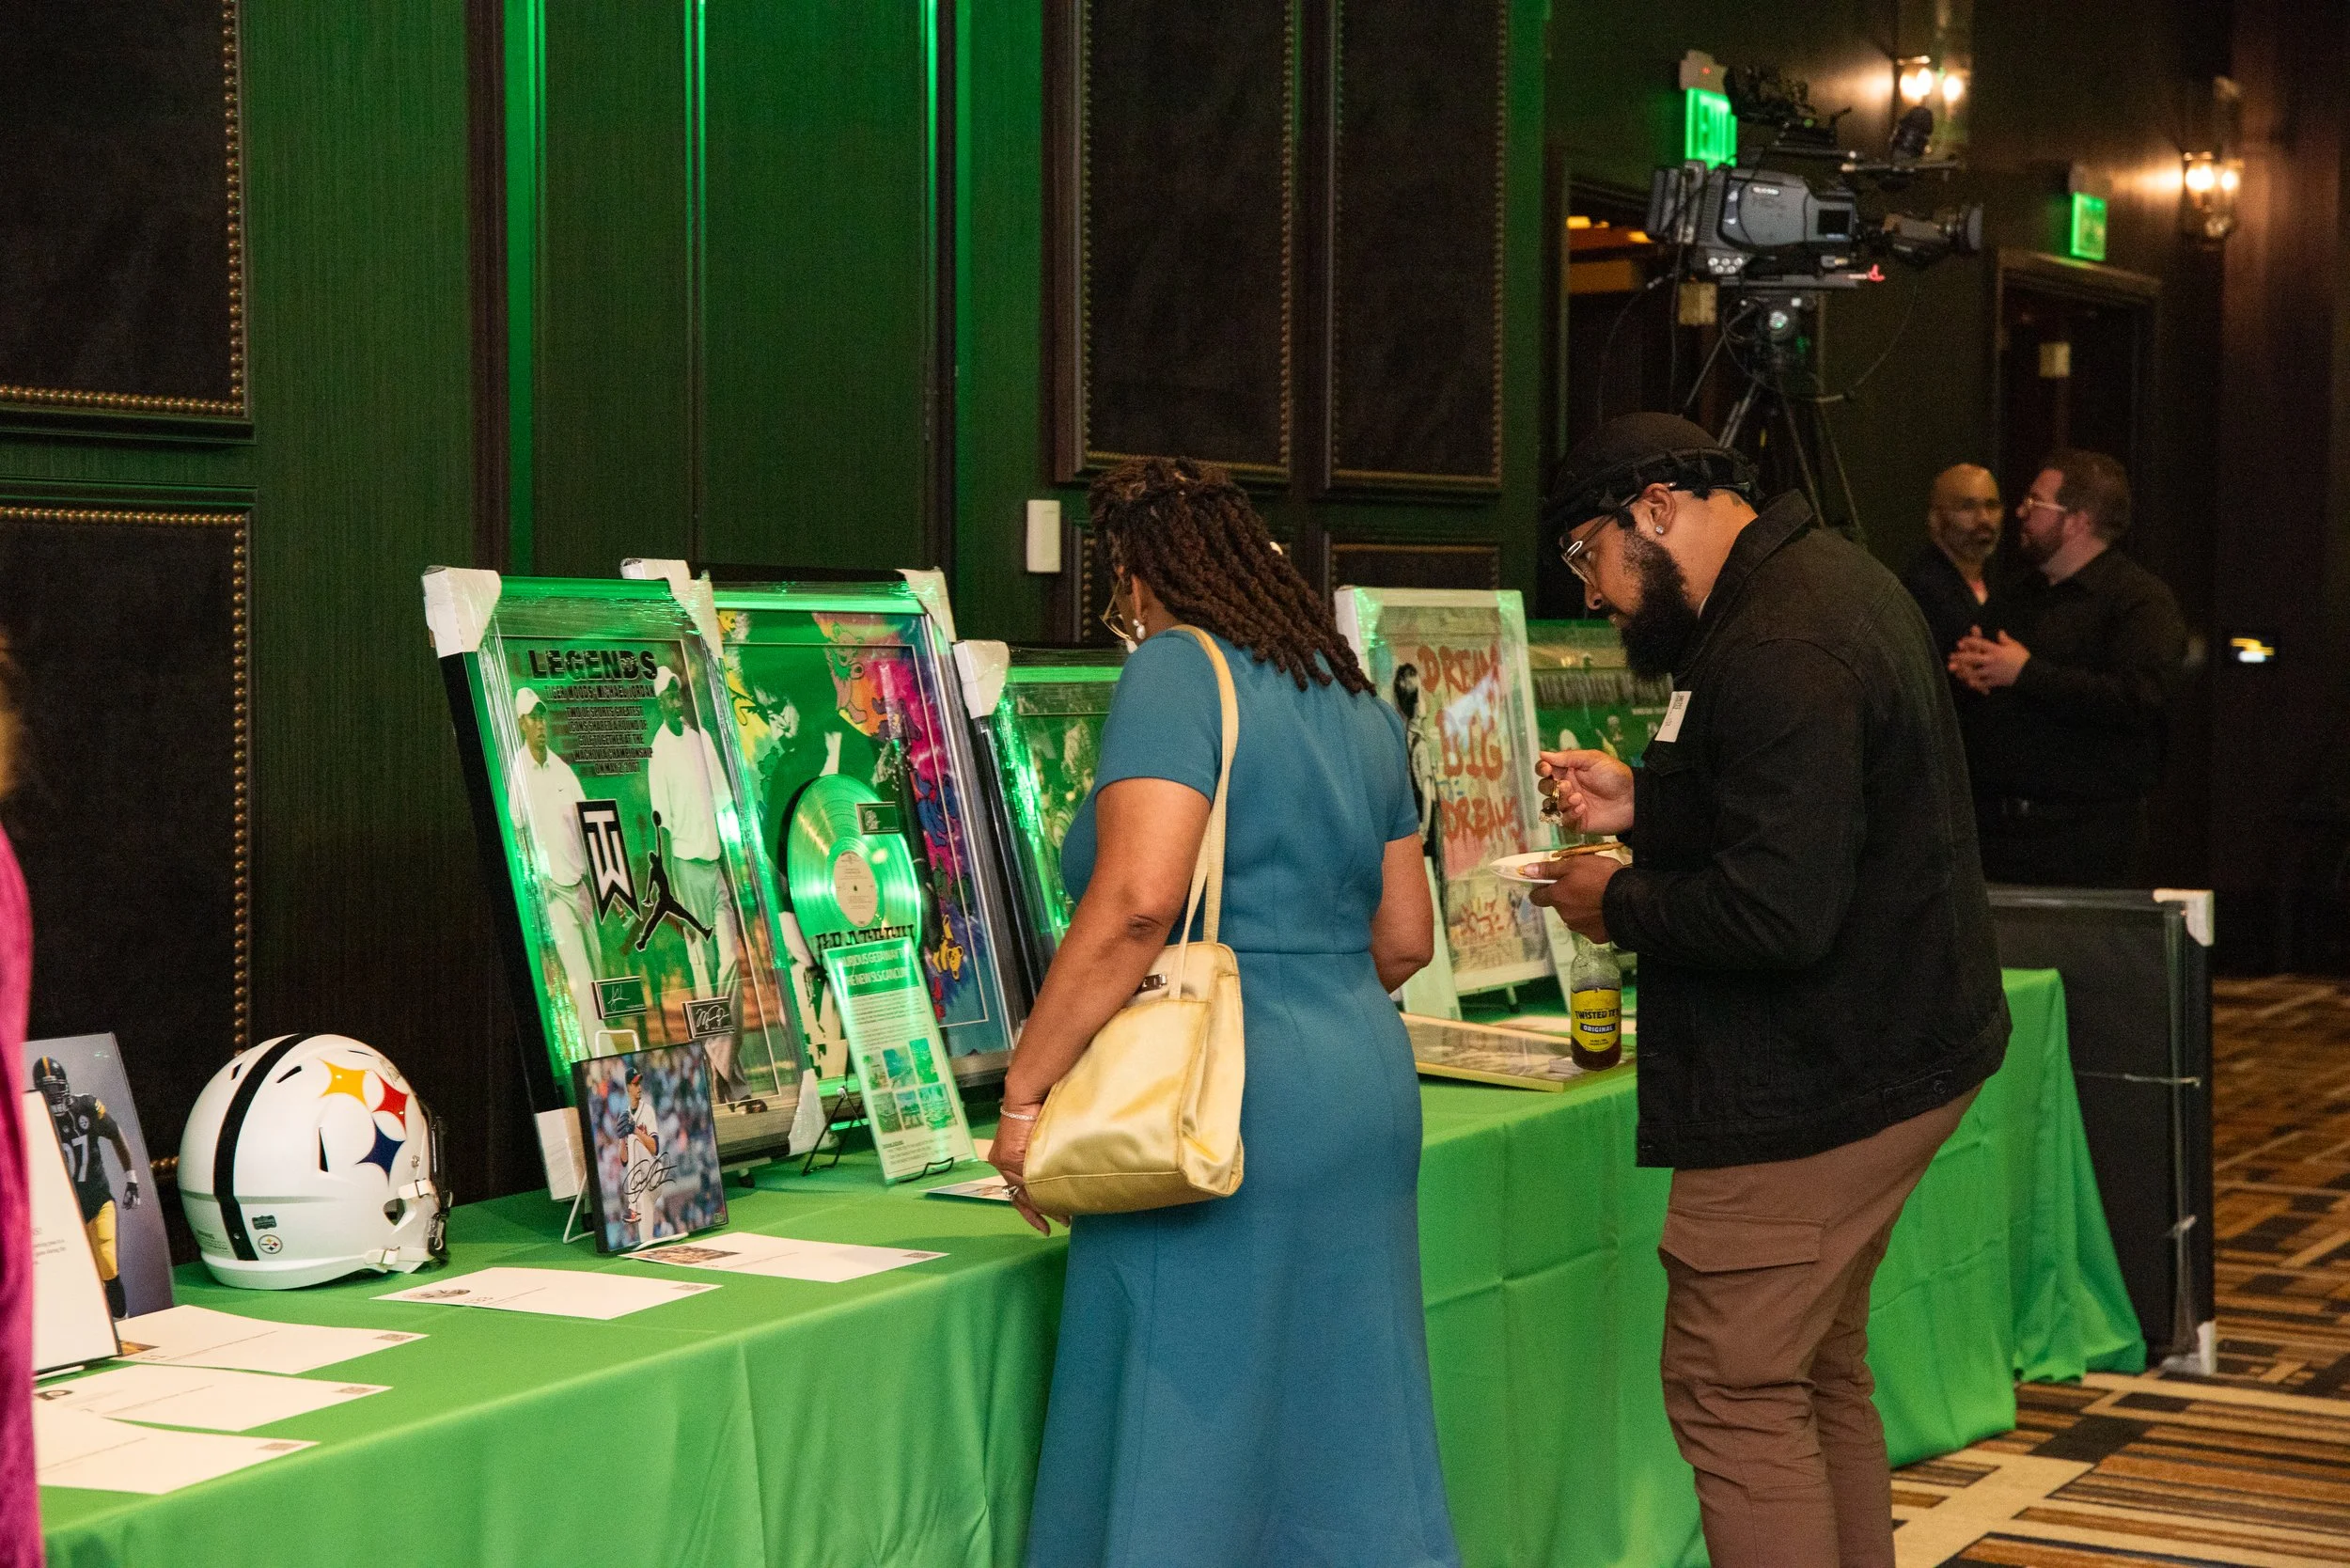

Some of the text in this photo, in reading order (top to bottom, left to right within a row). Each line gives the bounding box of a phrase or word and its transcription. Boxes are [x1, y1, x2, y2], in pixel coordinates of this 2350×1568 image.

[527, 650, 658, 681] LEGENDS
[1435, 710, 1503, 781] BIG
[1441, 797, 1528, 846] DREAMS
[1574, 1011, 1607, 1020] TWISTED
[1583, 1025, 1613, 1033] ORIGINAL
